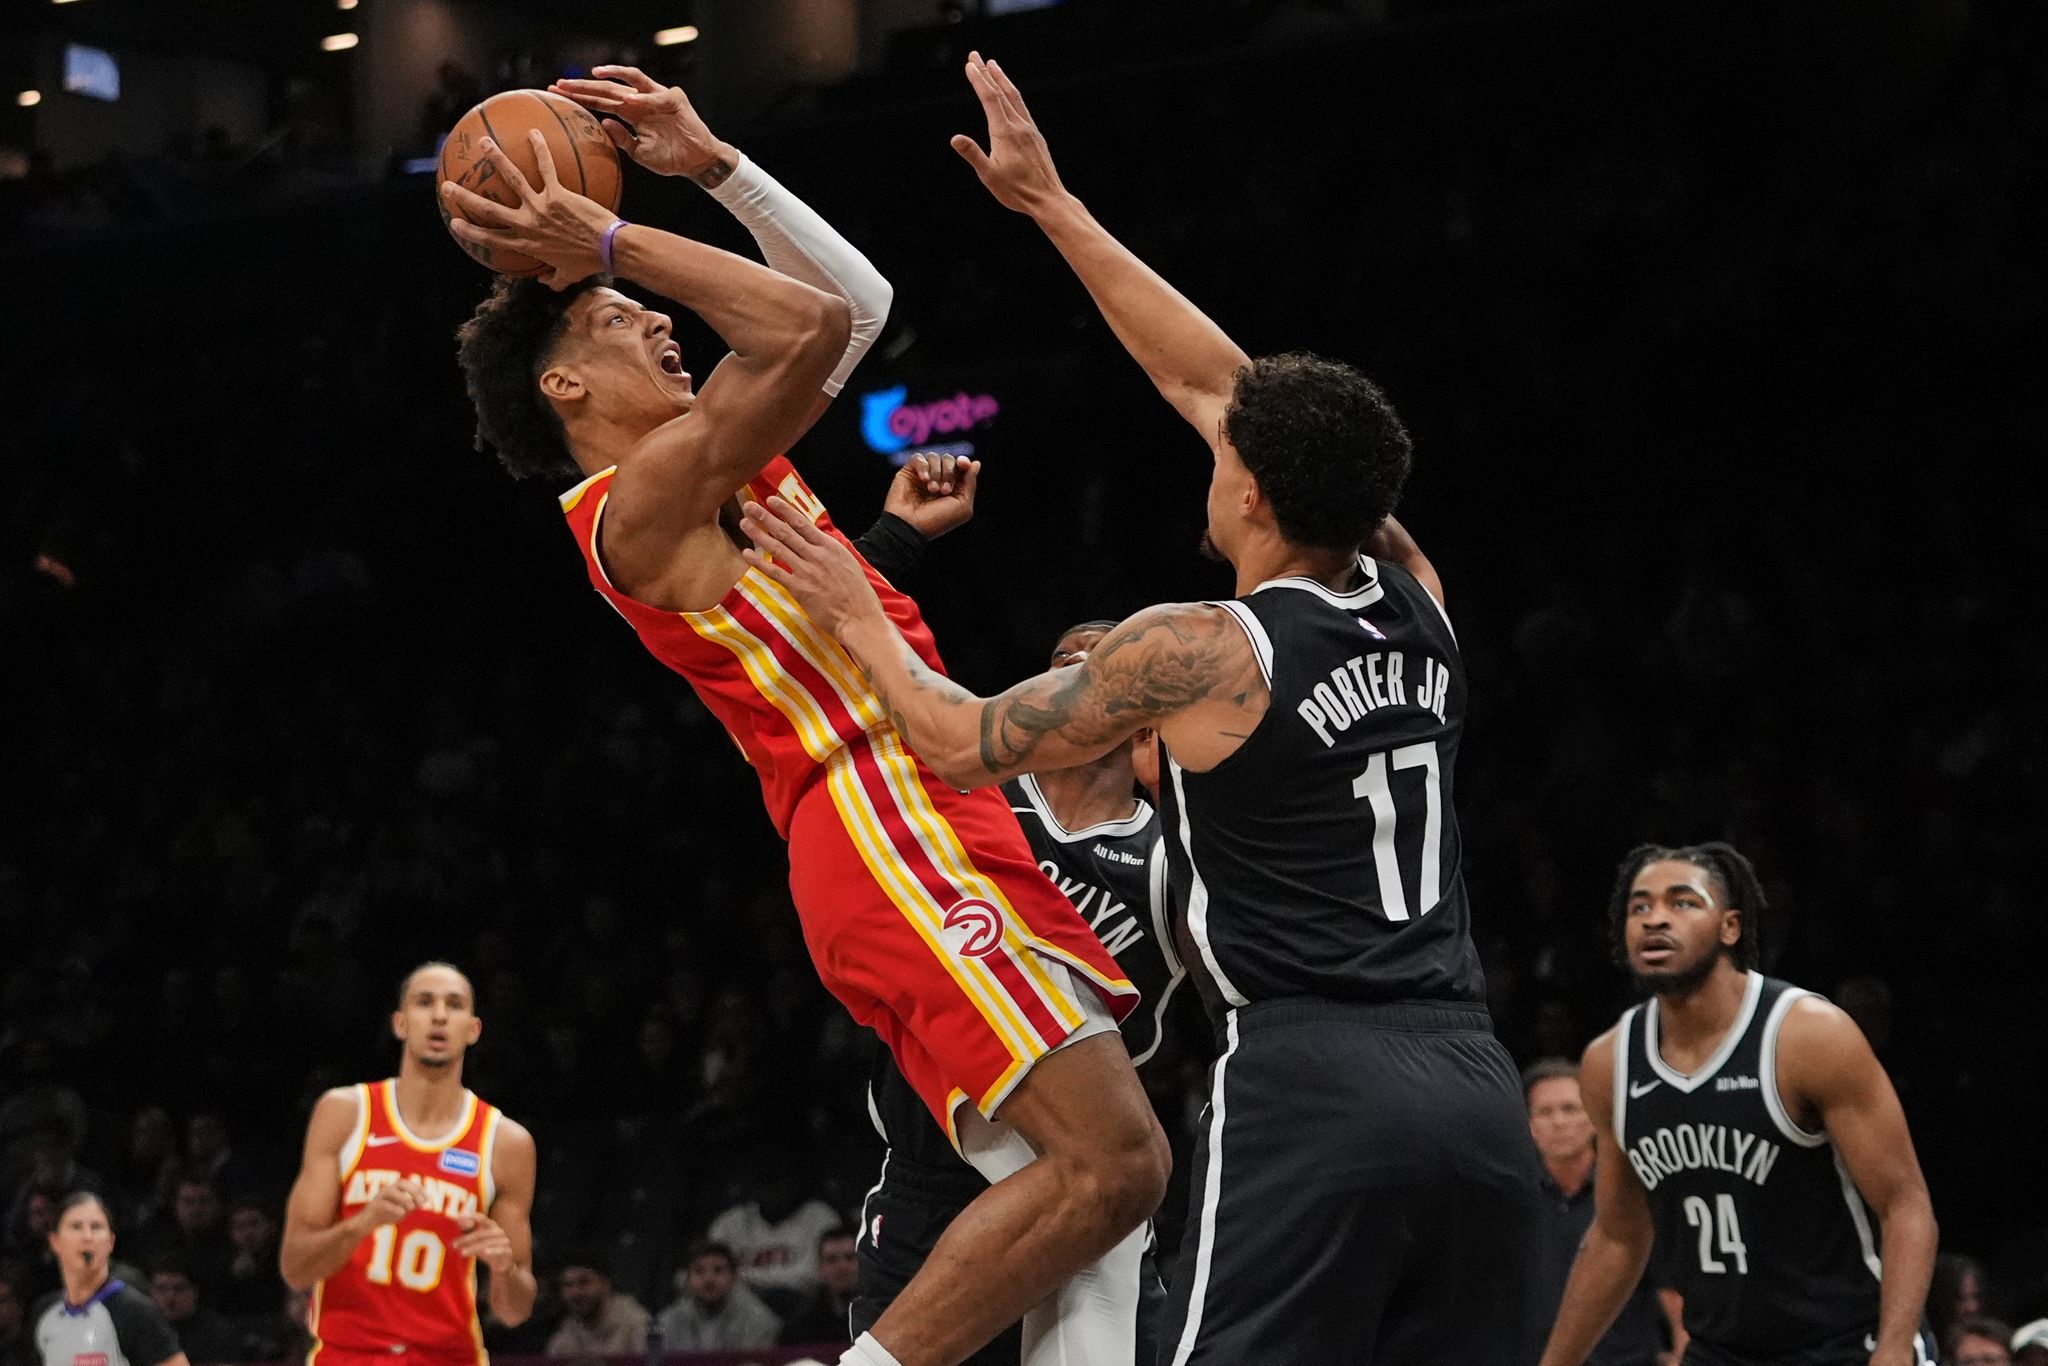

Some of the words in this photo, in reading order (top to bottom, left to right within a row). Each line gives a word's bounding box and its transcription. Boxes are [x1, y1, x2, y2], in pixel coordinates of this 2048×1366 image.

[1298, 651, 1407, 748] PORTER
[1093, 843, 1108, 858] All
[1108, 850, 1120, 862] In
[1120, 852, 1145, 866] Won
[1352, 741, 1441, 921] 17
[1628, 1123, 1780, 1190] BROOKLYN
[344, 1168, 478, 1218] ATNTA
[366, 1223, 446, 1293] 10
[1682, 1193, 1748, 1274] 24
